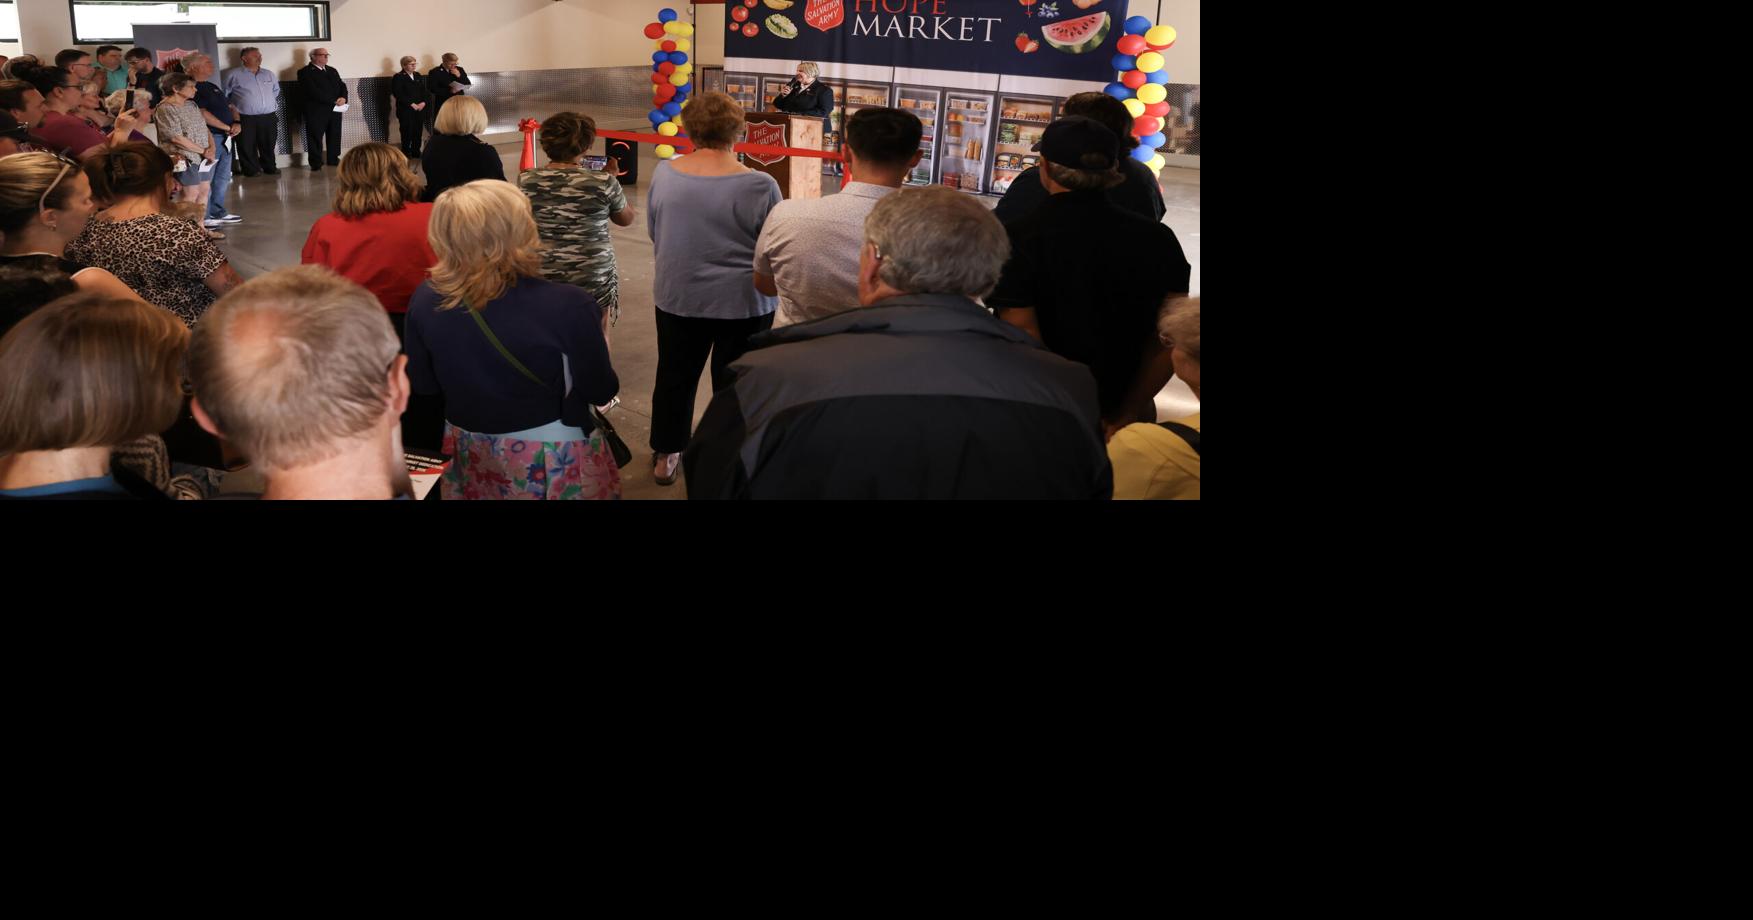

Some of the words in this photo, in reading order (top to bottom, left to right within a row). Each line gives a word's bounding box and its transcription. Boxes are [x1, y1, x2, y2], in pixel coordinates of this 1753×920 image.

[807, 0, 840, 21] SALVATION
[854, 0, 946, 14] HOPE
[818, 8, 839, 26] ARMY
[852, 14, 1002, 42] MARKET
[753, 127, 768, 140] THE
[754, 129, 780, 145] LVATION
